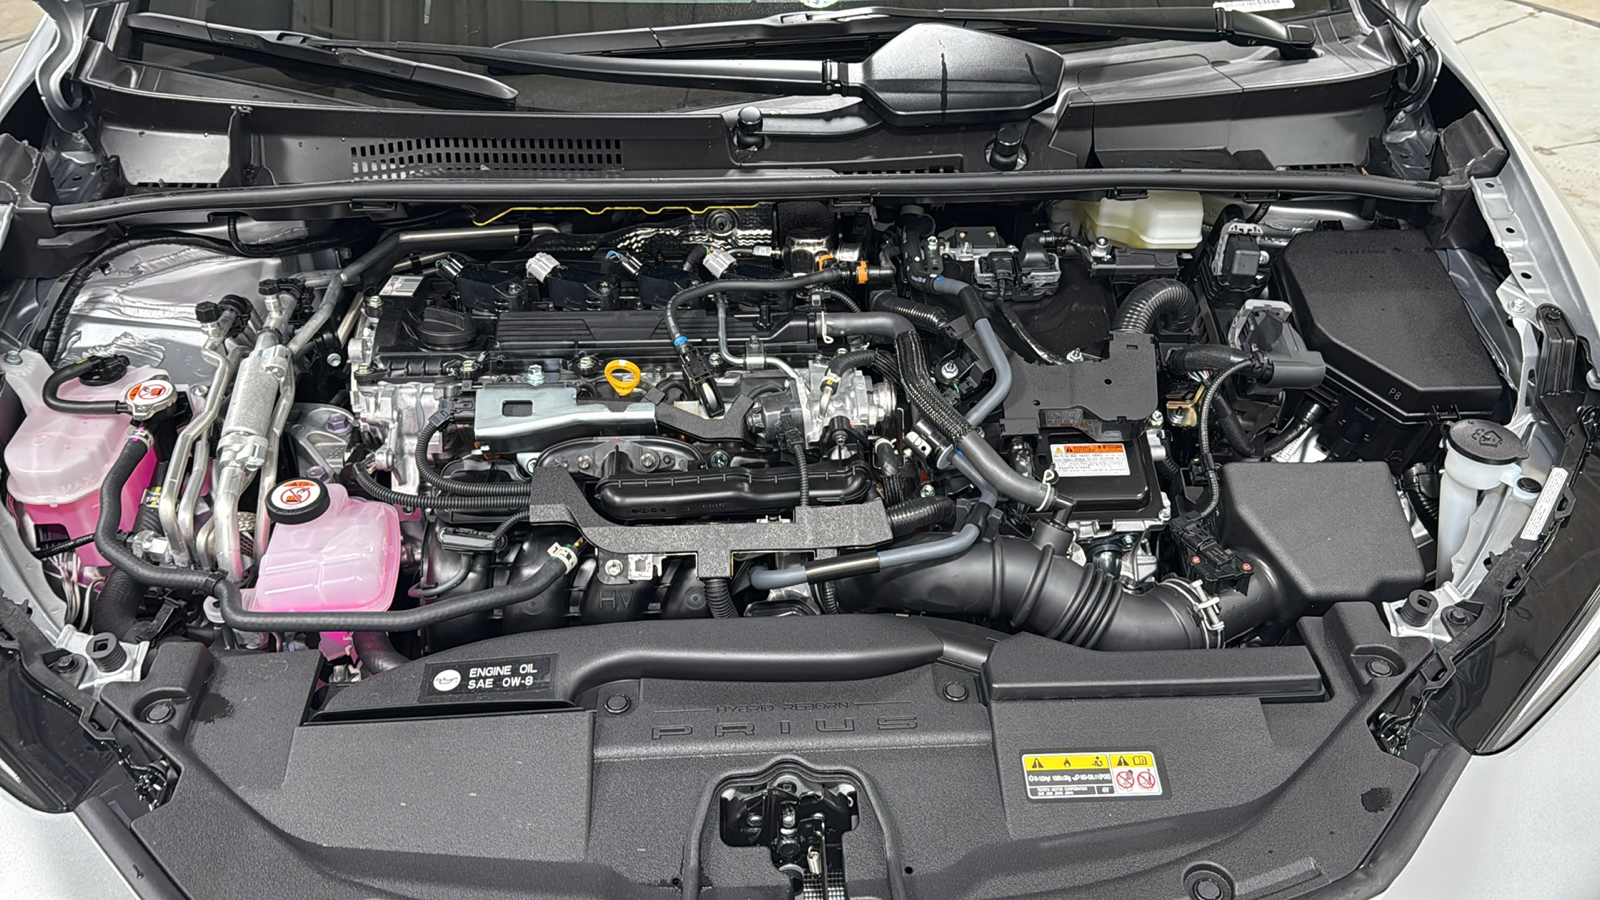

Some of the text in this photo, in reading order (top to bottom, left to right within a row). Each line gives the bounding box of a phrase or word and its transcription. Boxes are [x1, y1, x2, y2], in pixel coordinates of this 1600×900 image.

[1388, 387, 1402, 400] P8
[600, 589, 634, 609] HV
[468, 663, 537, 677] ENGINE OIL
[467, 678, 493, 689] SAE
[716, 701, 849, 713] HYBRID REBORN
[651, 716, 918, 740] PRIUS
